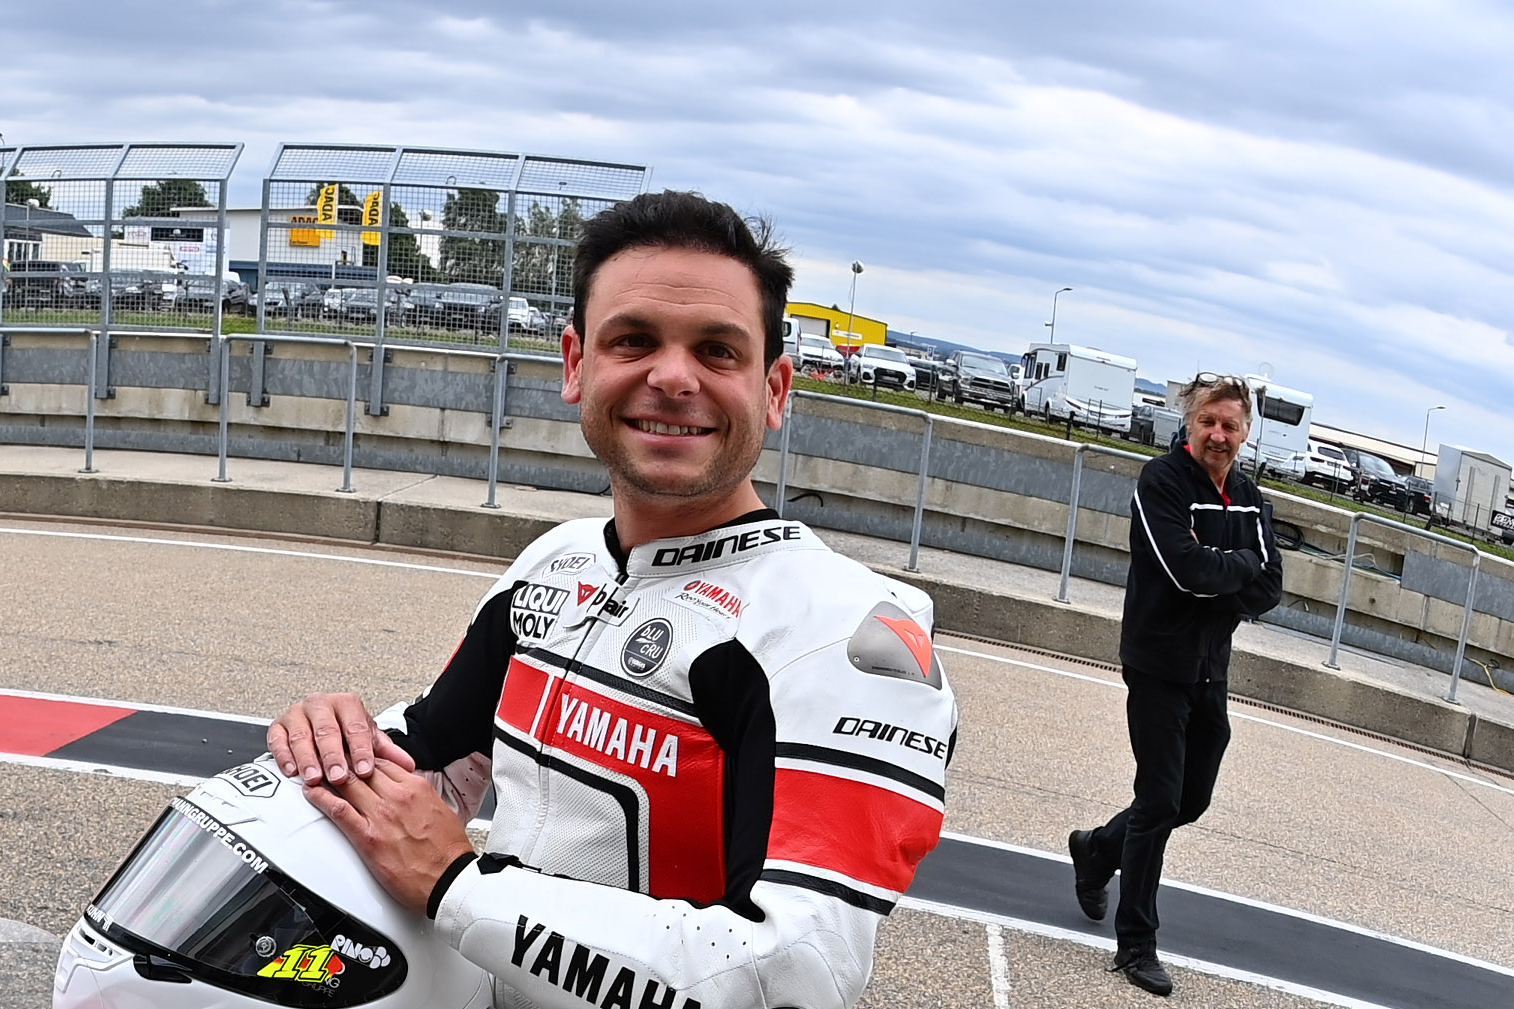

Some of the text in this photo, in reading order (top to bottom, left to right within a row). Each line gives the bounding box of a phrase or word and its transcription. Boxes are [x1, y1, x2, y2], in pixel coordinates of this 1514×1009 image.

[651, 526, 801, 568] DAINESE
[514, 585, 568, 614] LIQUI
[694, 582, 742, 618] YAMAHA
[513, 611, 556, 640] MOLY
[558, 693, 680, 778] YAMAHA
[833, 717, 948, 759] DAINESE
[272, 944, 333, 982] 11
